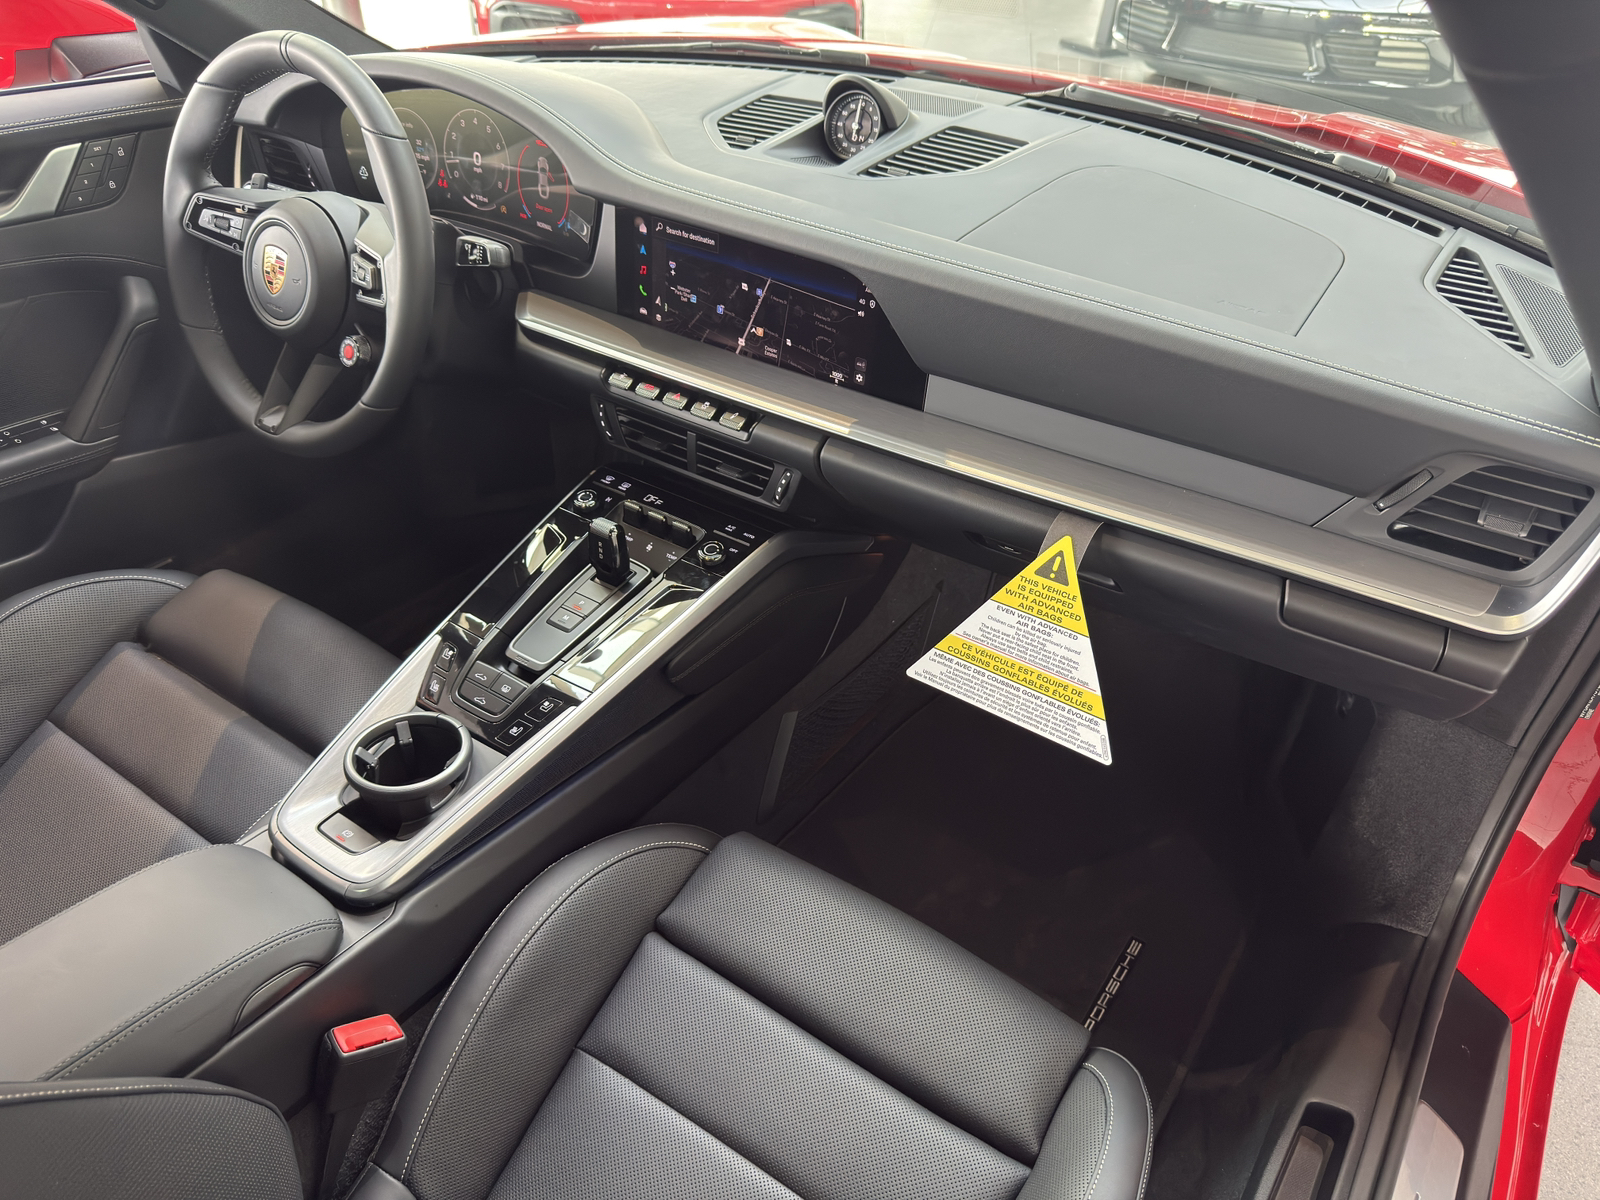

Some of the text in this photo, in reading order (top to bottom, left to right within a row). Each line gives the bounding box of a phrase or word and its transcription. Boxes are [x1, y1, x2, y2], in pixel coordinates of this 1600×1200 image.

[473, 152, 481, 166] 0
[666, 226, 681, 237] Search
[689, 233, 715, 246] destination
[643, 494, 664, 505] OFF
[1017, 583, 1074, 610] IS EQUIPPED
[1018, 575, 1077, 602] THIS VEHICLE
[1004, 587, 1081, 622] WITH ADVANCED
[1017, 601, 1063, 624] AIR BAGS
[996, 604, 1078, 641] EVEN WITH ADVANCED
[1016, 619, 1053, 638] AIR BAGS:
[947, 645, 1094, 711] COUSSINS GONFLABLES ÉVOLUÉS
[961, 642, 1083, 698] CE VÉHICULE EST ÉQUIPÉ DE
[933, 651, 1101, 726] MÊME AVEC DES COUSSINS GONFLABLES ÉVOLUÉS:
